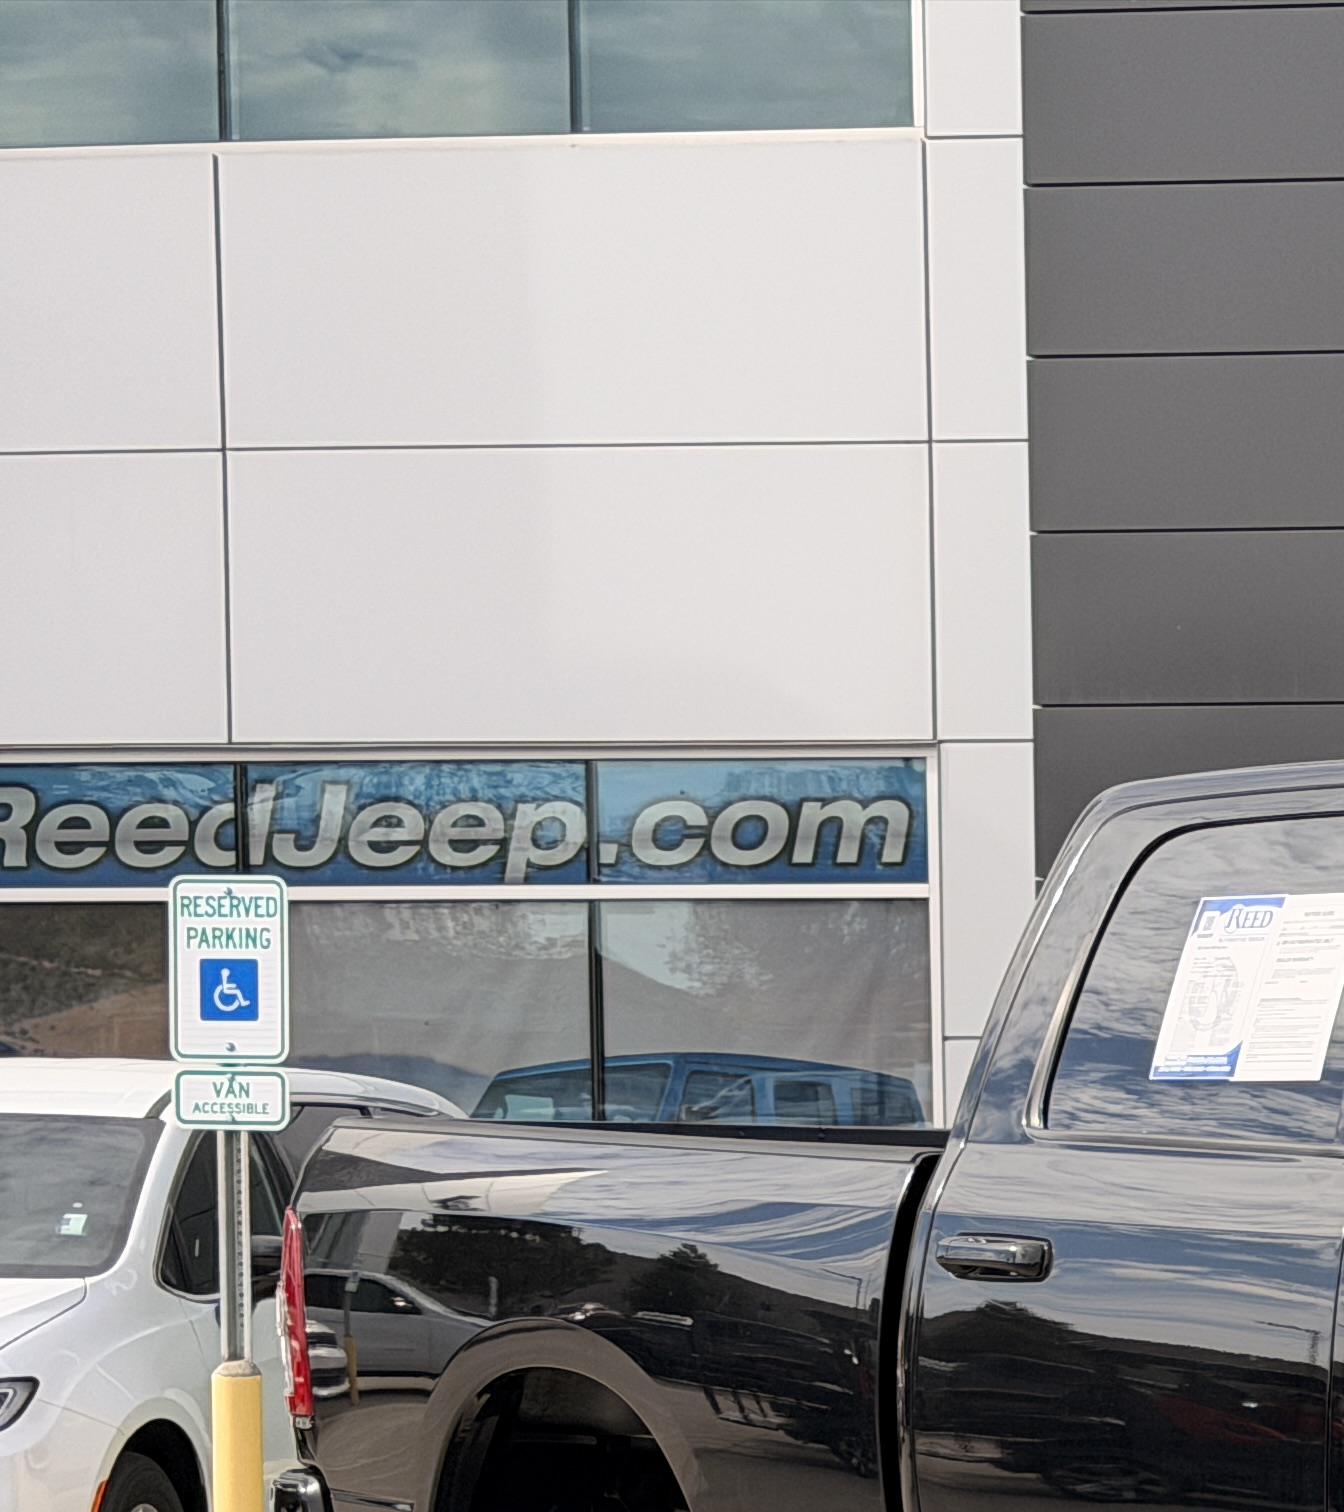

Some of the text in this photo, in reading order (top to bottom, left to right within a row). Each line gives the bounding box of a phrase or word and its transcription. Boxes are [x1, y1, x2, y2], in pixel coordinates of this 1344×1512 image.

[179, 895, 278, 918] RESERVED
[1223, 907, 1274, 934] REED
[185, 926, 272, 950] PARKING
[211, 1081, 251, 1099] VAN
[191, 1102, 270, 1115] ACCESSIBLE
